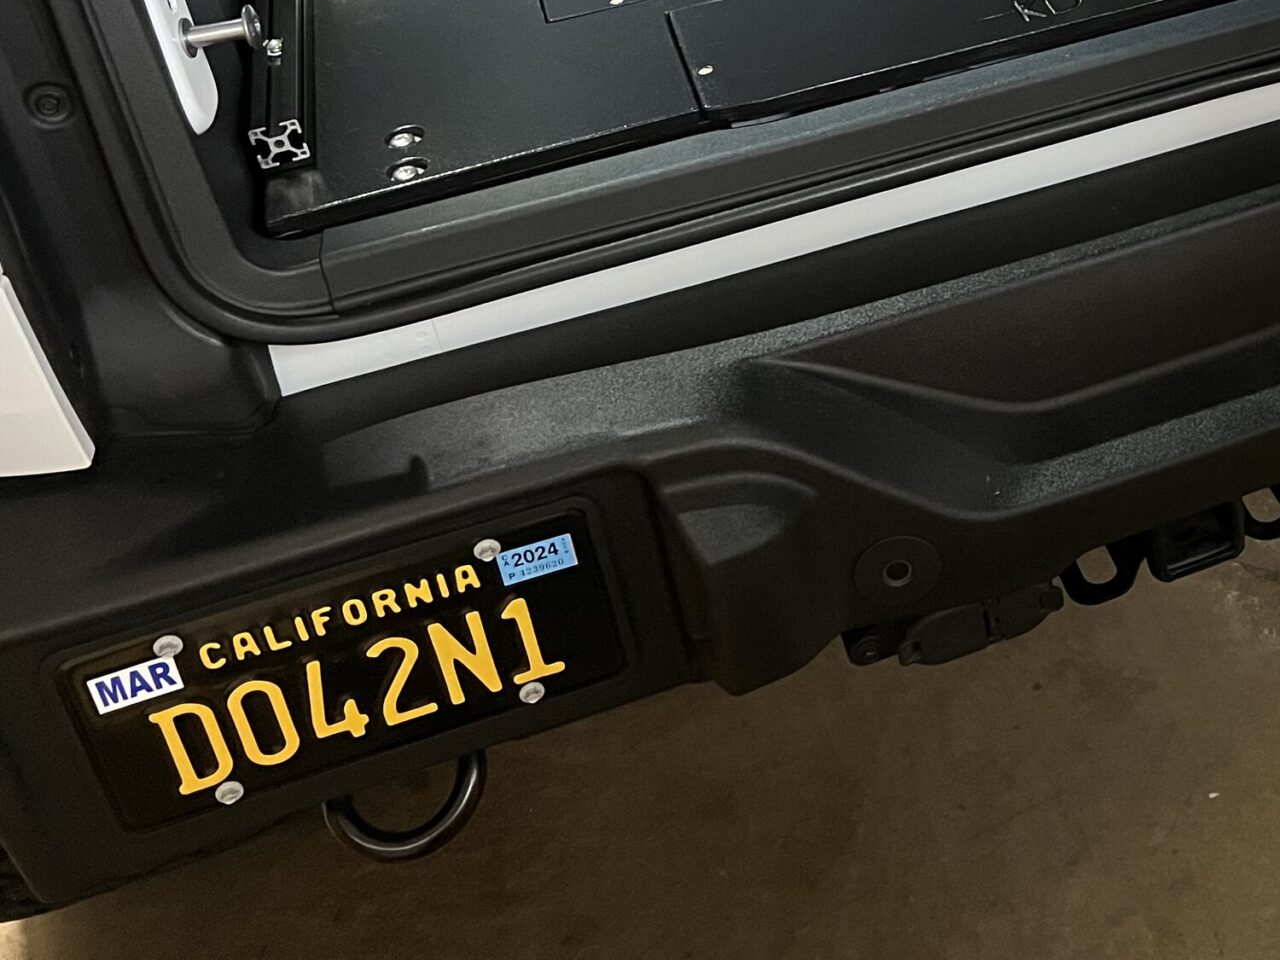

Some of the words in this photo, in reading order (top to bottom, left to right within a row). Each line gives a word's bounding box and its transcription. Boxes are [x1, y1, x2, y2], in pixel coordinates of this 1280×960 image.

[511, 542, 558, 567] 2024
[200, 565, 481, 669] CALIFORNIA
[95, 662, 177, 707] MAR
